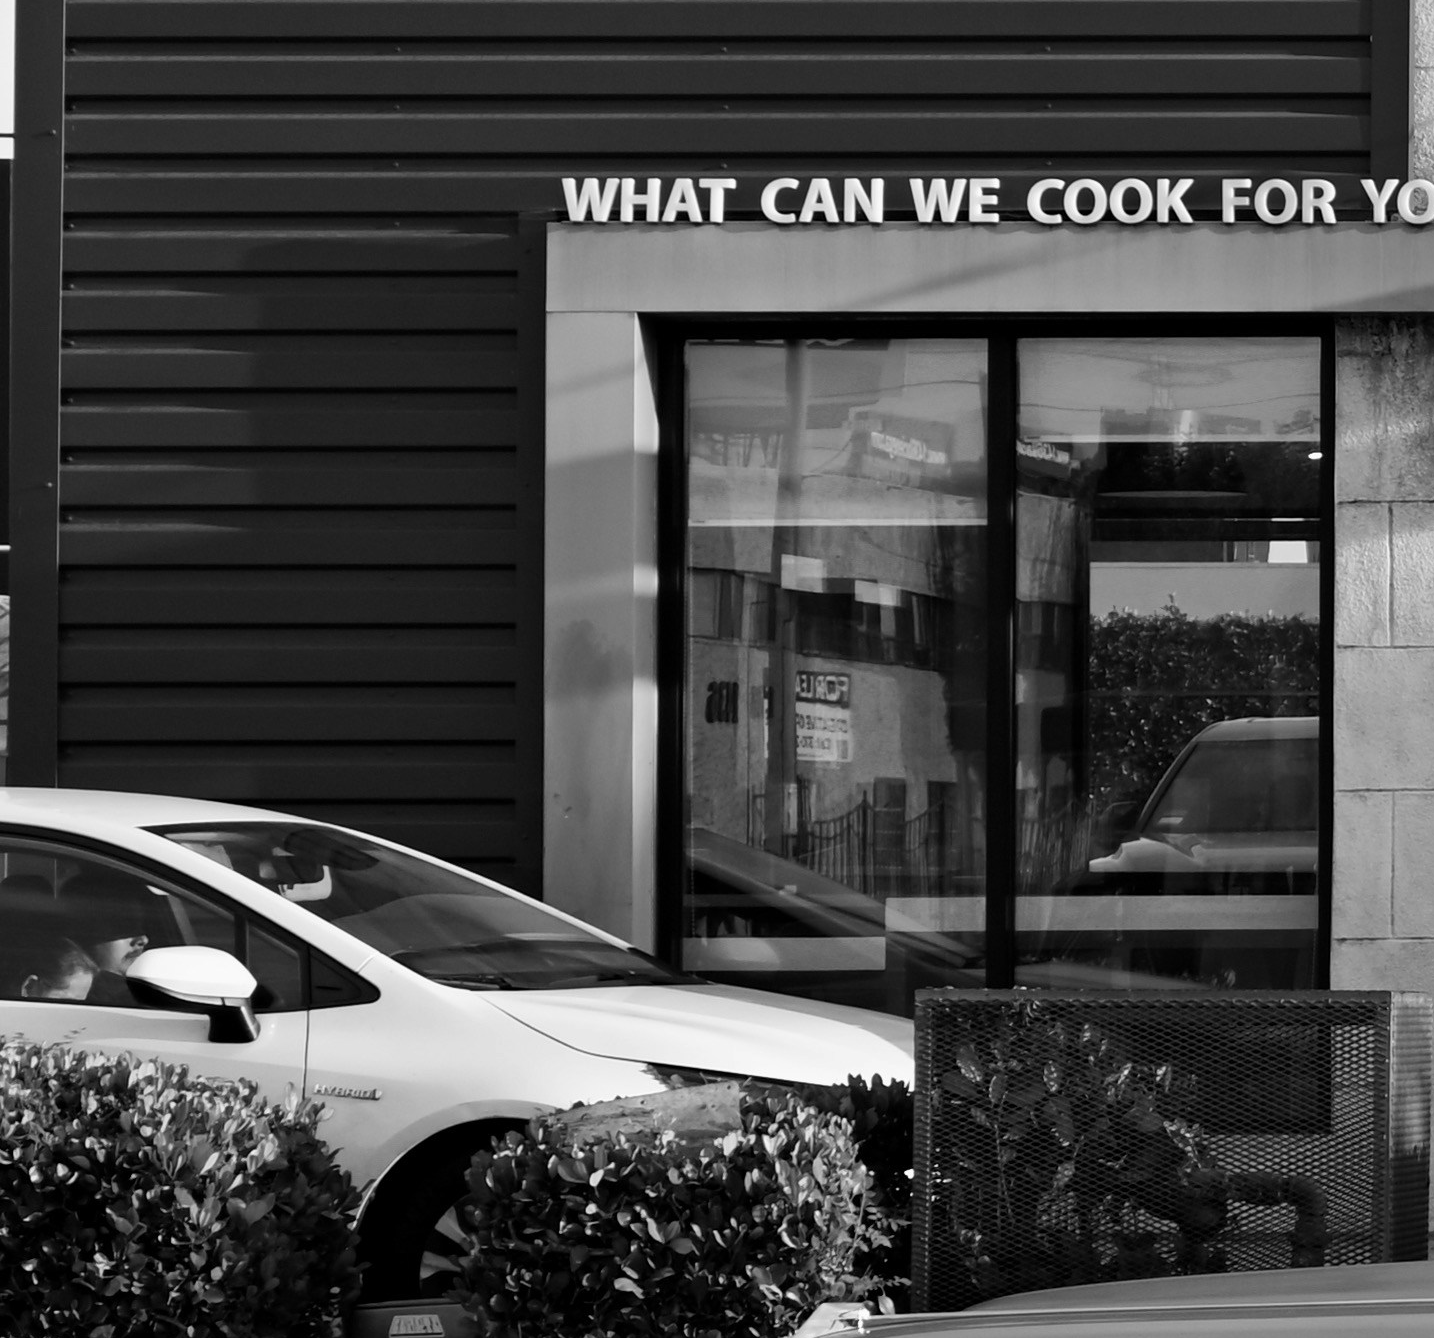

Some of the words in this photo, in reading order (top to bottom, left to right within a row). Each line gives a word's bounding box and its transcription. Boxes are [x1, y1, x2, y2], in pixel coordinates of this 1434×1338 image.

[562, 177, 738, 224] WHAT
[760, 176, 885, 224] CAN
[909, 177, 1001, 224] WE
[1026, 177, 1195, 225] COOK
[1222, 178, 1338, 225] FOR
[314, 1083, 372, 1099] HYBRID
